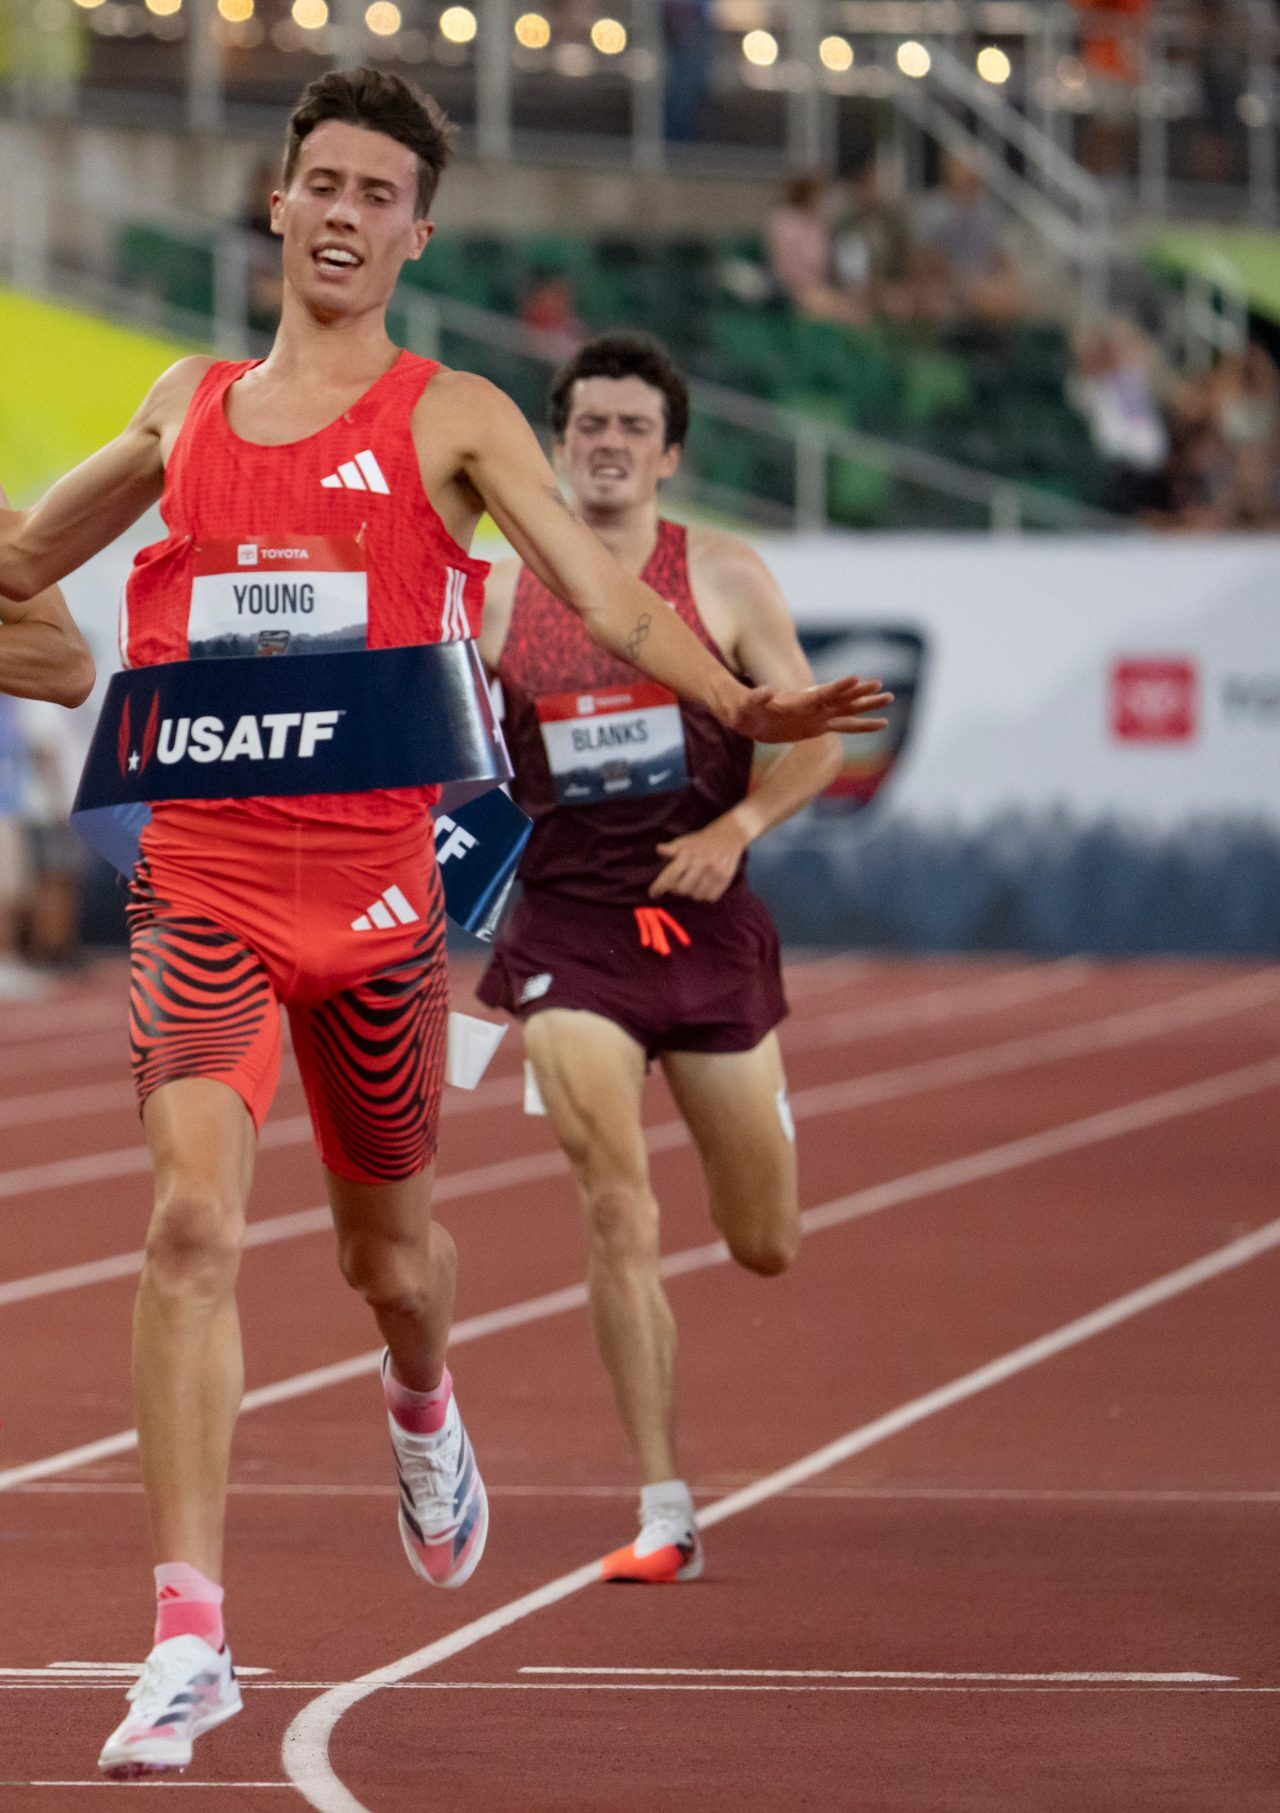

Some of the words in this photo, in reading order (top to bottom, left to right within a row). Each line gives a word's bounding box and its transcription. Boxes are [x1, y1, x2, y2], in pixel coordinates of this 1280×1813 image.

[261, 548, 309, 559] TOYOTA
[233, 583, 315, 615] YOUNG
[156, 710, 340, 765] USATF
[572, 719, 648, 752] BLANKS
